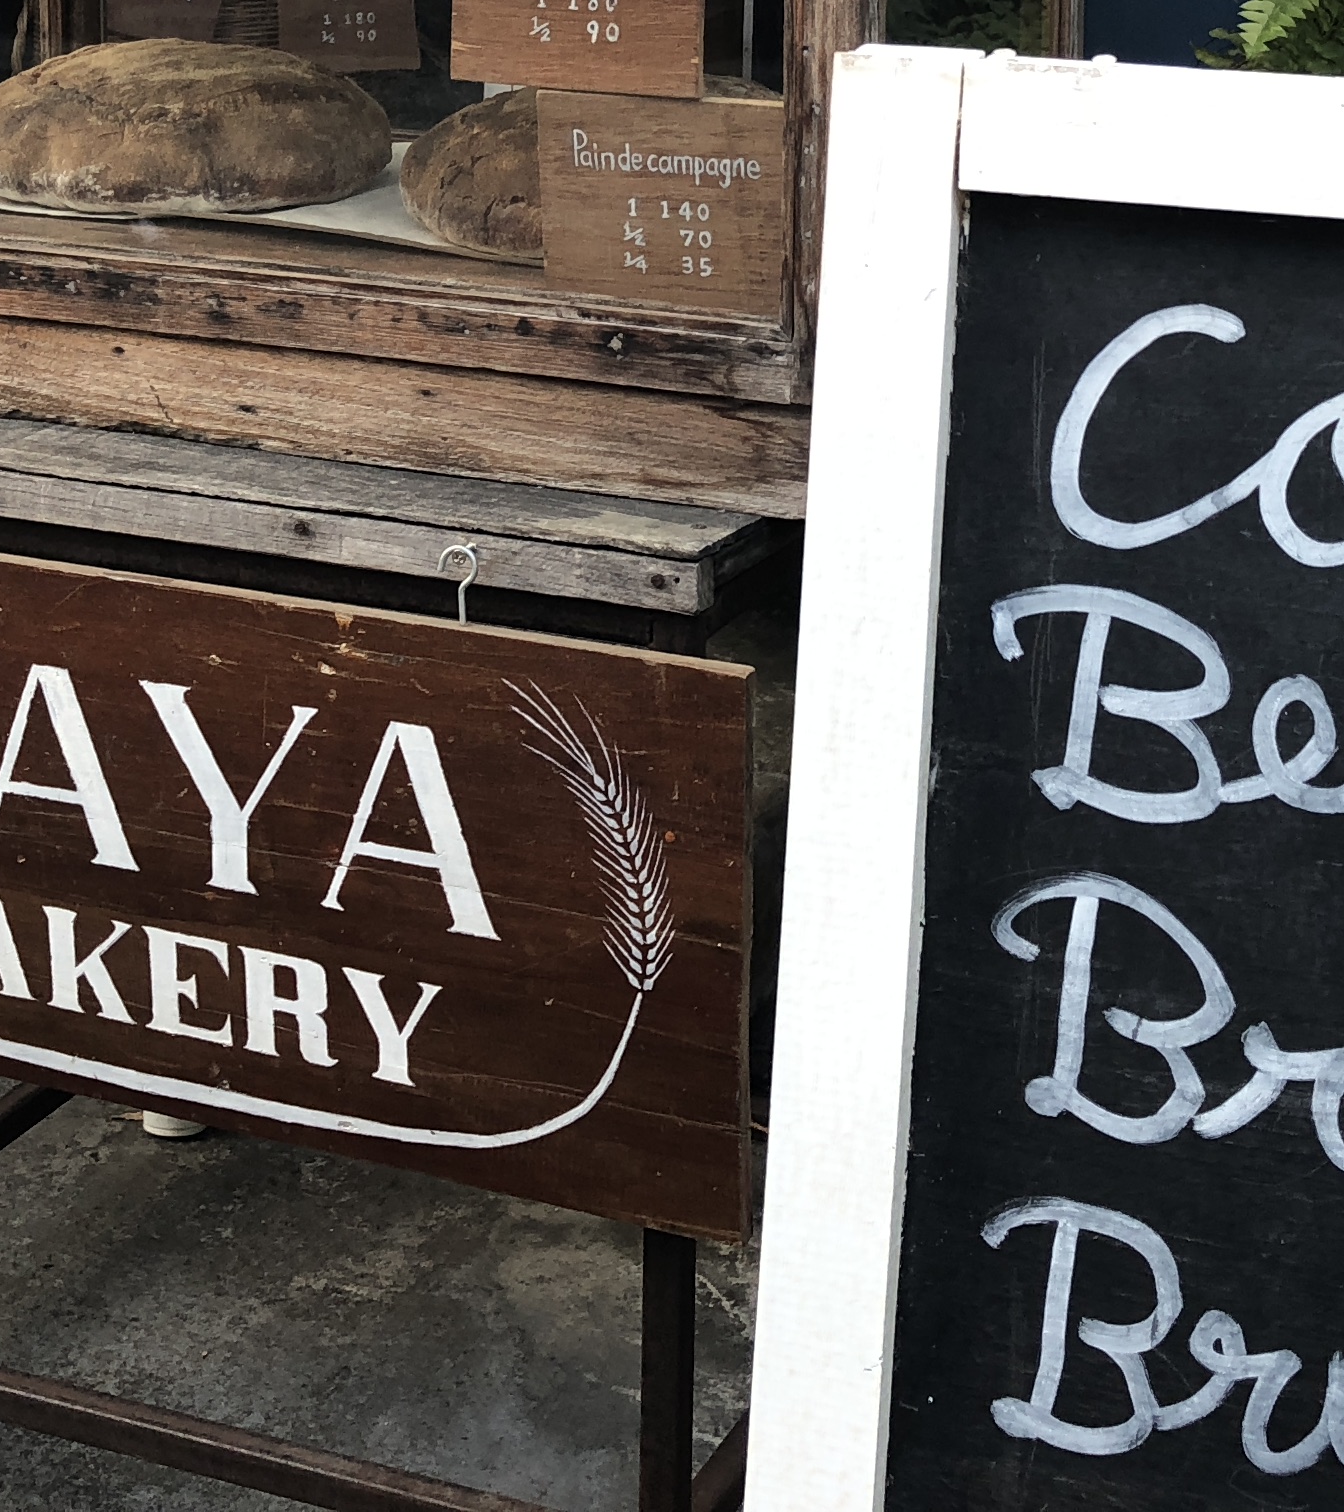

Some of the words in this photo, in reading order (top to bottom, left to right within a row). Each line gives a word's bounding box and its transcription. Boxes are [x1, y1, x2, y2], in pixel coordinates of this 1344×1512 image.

[586, 20, 620, 44] 90
[627, 198, 638, 217] 1
[660, 201, 710, 222] 140
[679, 229, 713, 248] 70
[682, 256, 714, 277] 35
